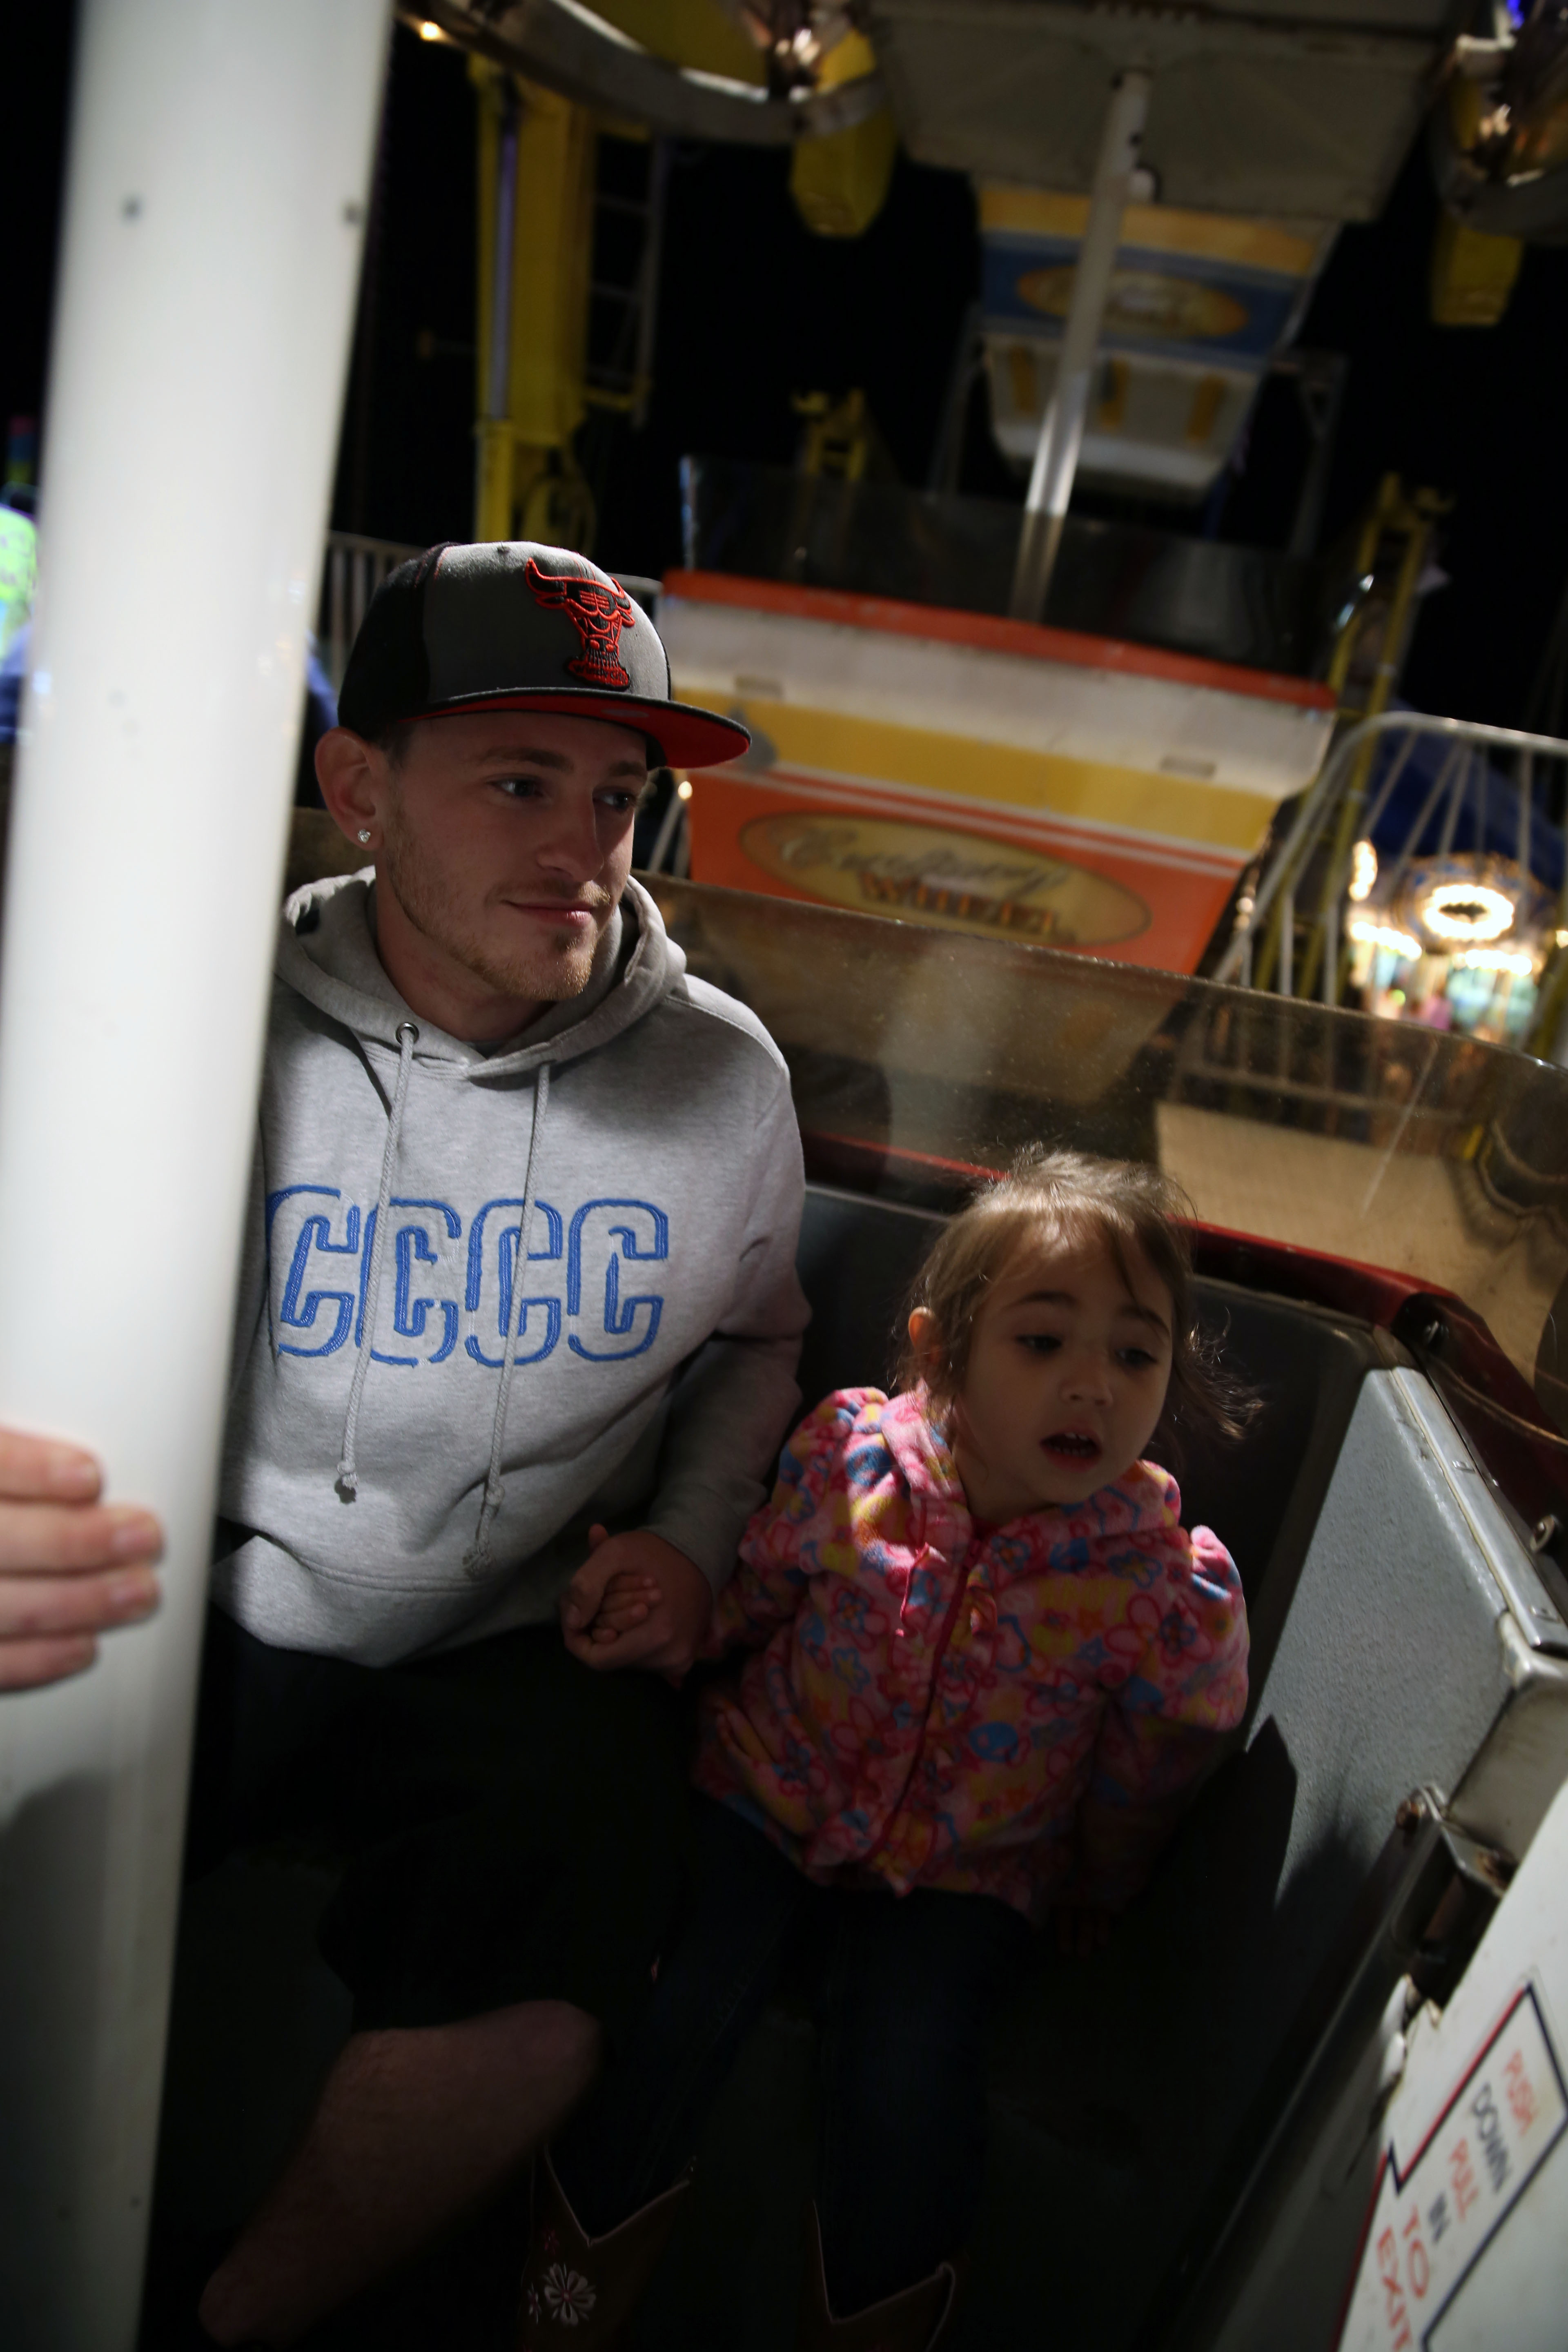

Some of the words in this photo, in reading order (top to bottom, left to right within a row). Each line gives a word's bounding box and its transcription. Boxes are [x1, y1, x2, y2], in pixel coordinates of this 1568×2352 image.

[266, 1185, 668, 1366] CCCC
[1450, 2140, 1477, 2218] PULL
[1472, 2084, 1511, 2192] DOWN
[1377, 2227, 1413, 2351] EXIT
[1403, 2206, 1429, 2299] TO
